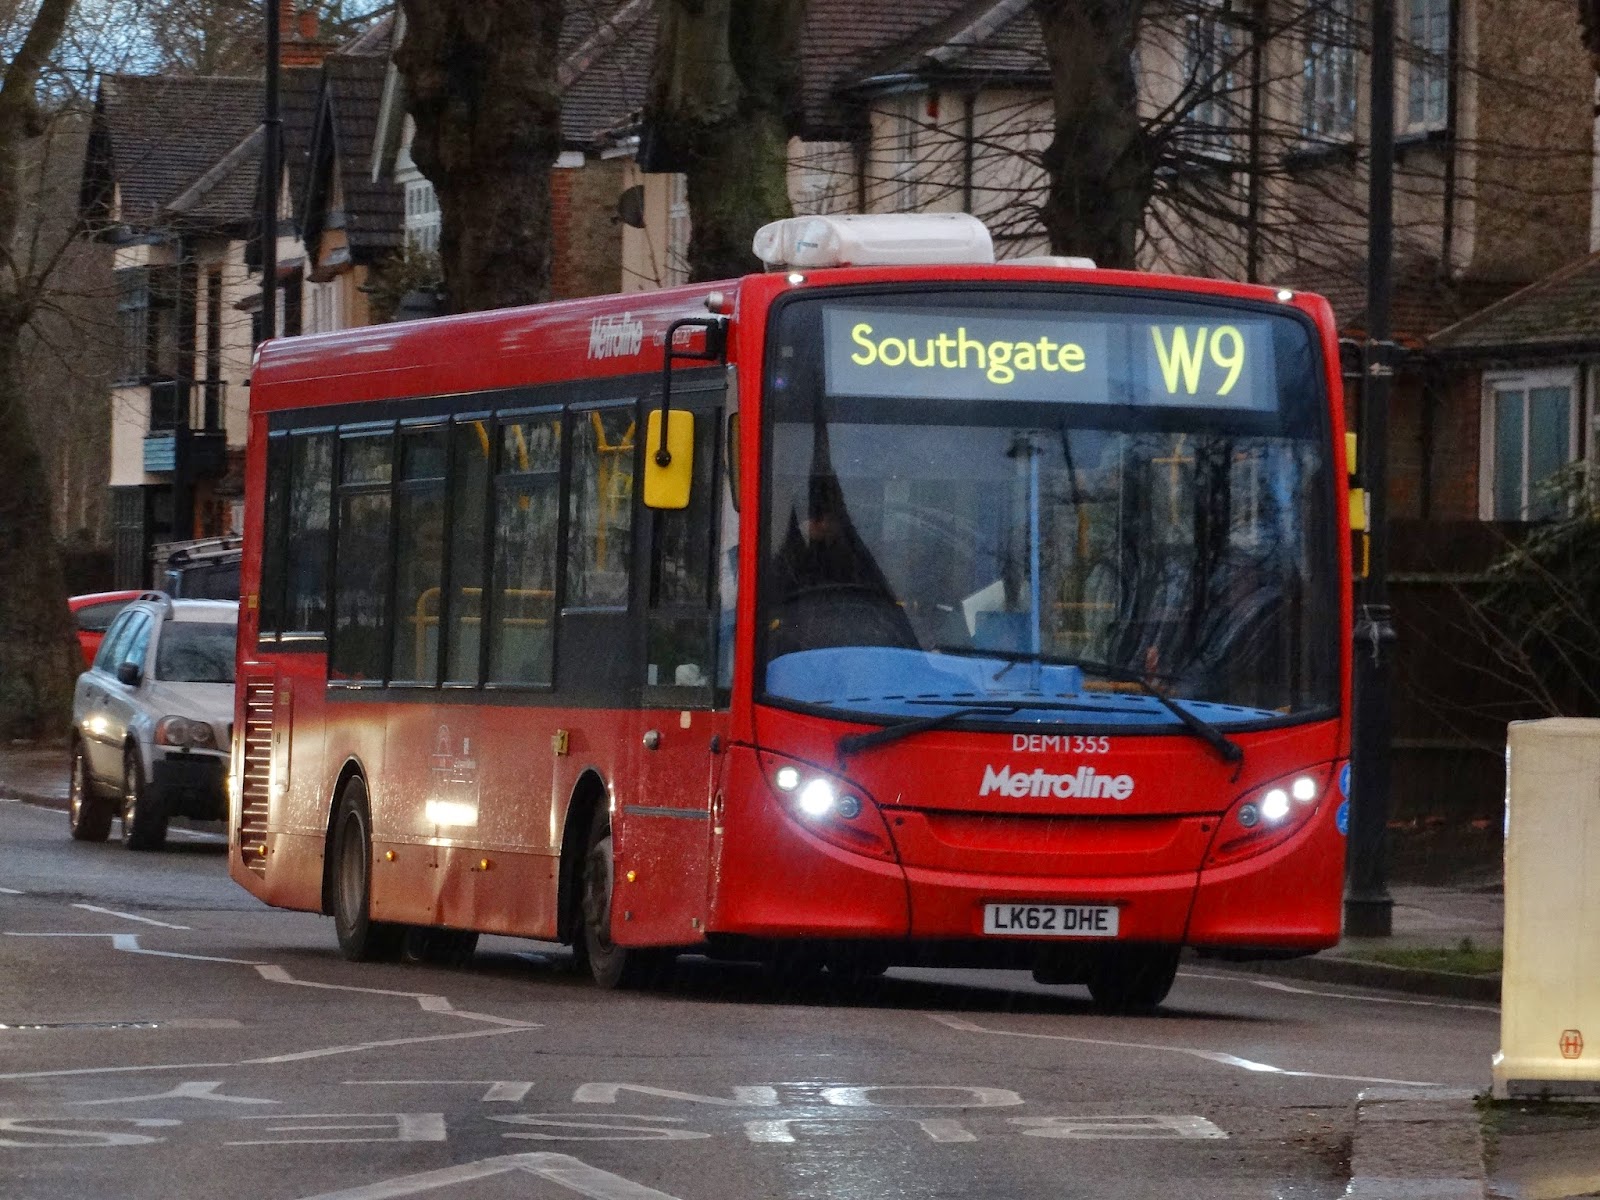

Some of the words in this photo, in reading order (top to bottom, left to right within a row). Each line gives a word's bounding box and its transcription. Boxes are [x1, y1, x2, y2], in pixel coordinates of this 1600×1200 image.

[588, 312, 643, 359] Metroline
[851, 323, 1086, 384] Southgate
[1151, 325, 1245, 396] W9
[1012, 734, 1110, 754] DEM1355
[979, 764, 1135, 800] Metroline
[994, 907, 1056, 930] LK62
[1063, 908, 1109, 930] DHE
[62, 1080, 1025, 1108] ONLY
[0, 1112, 1230, 1148] BUSES
